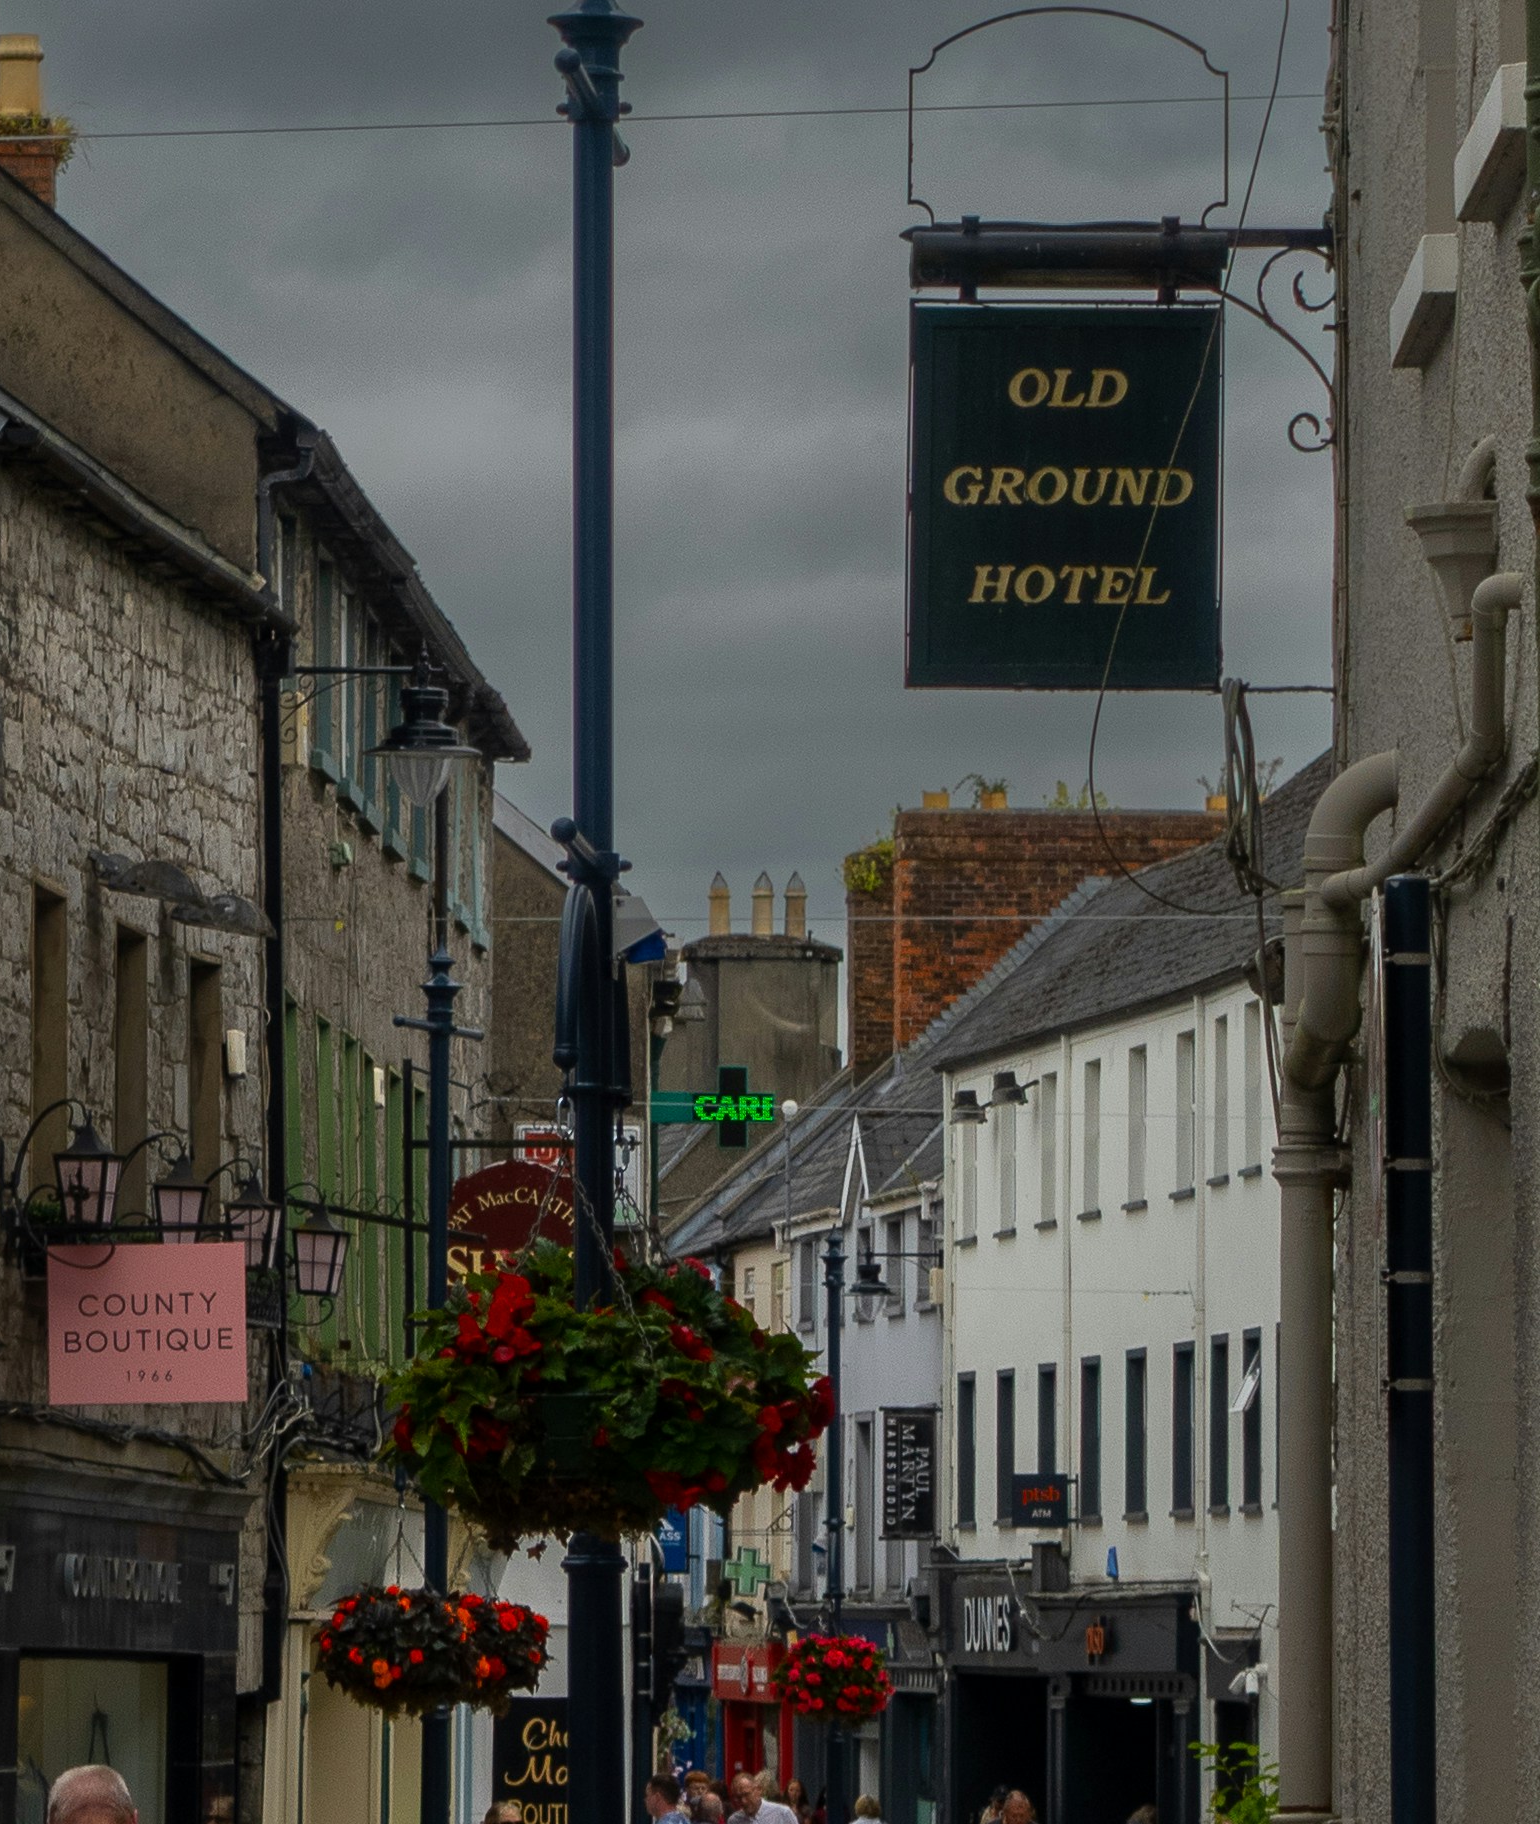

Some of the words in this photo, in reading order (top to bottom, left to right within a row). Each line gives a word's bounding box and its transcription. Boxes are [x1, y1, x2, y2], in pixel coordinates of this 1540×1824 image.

[1007, 367, 1130, 409] OLD
[942, 465, 1194, 508] GROUND
[967, 563, 1172, 607] HOTEL
[77, 1291, 217, 1318] COUNTY
[63, 1327, 234, 1354] BOUTIQUE
[126, 1368, 174, 1383] 1966
[901, 1424, 916, 1521] MARTYN
[915, 1446, 930, 1498] PAUL
[1021, 1485, 1061, 1506] ptsb
[1031, 1508, 1053, 1519] ATM
[964, 1594, 1011, 1654] DUNNES
